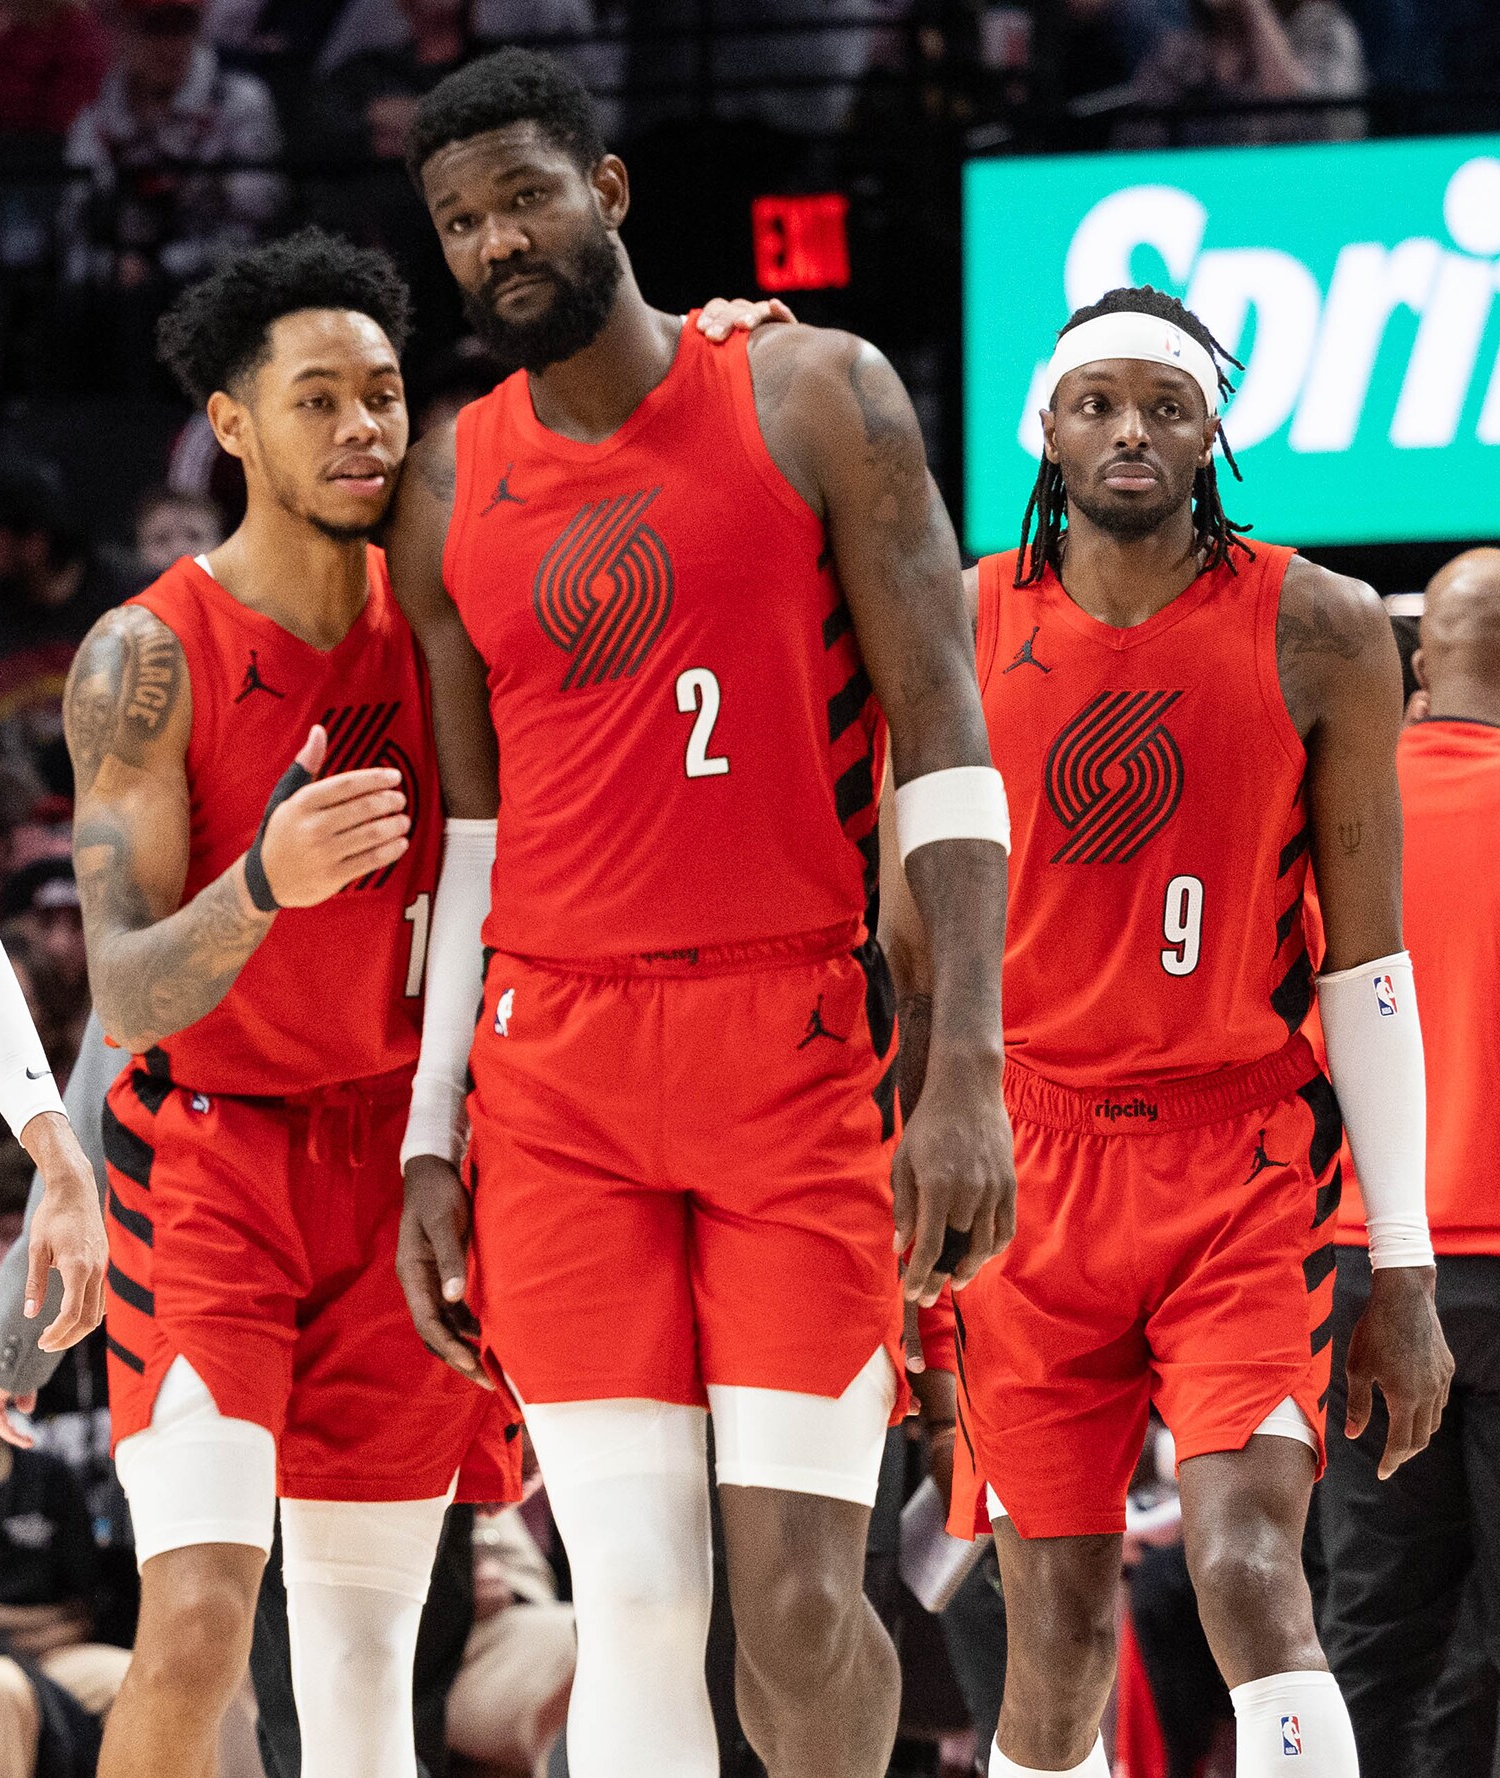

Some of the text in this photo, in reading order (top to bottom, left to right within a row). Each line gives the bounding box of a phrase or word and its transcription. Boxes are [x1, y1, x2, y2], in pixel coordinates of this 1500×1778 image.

[1018, 156, 1500, 460] Spri
[675, 666, 730, 779] 2
[403, 891, 430, 998] 1
[1160, 874, 1204, 977] 9
[1095, 1098, 1159, 1122] ripcity
